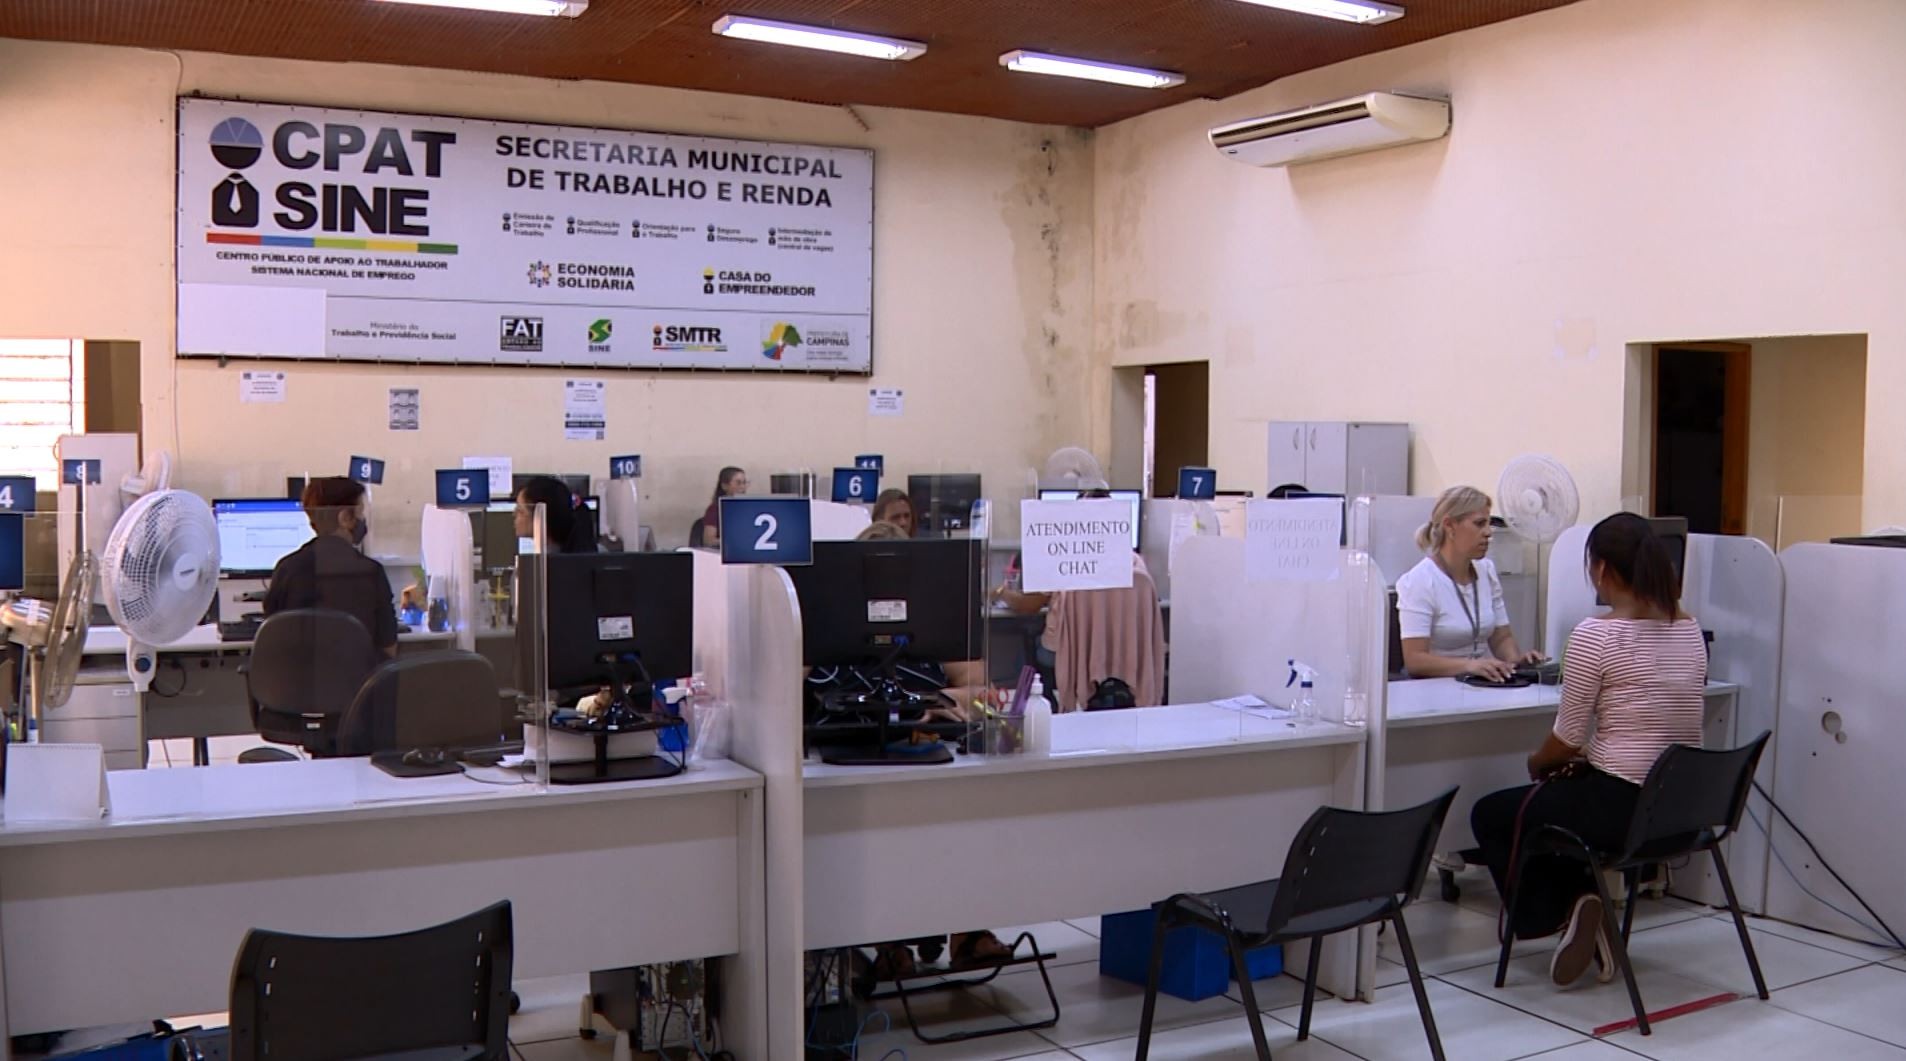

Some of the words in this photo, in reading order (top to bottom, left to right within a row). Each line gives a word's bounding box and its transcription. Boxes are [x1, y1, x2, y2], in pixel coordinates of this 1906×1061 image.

[272, 120, 457, 178] CPAT
[495, 136, 678, 168] SECRETARIA
[688, 150, 842, 179] MUNICIPAL
[507, 168, 545, 190] DE
[554, 171, 707, 200] TRABALHO
[717, 182, 732, 201] E
[742, 183, 833, 208] RENDA
[272, 181, 430, 237] SINE
[216, 251, 259, 261] CENTRO
[261, 252, 305, 263] PÚBLICO
[308, 255, 321, 264] DE
[324, 256, 355, 265] APOIO
[357, 258, 372, 266] AO
[375, 258, 448, 269] TRABALHADOR
[251, 265, 295, 275] SISTEMA
[296, 268, 349, 278] NACIONAL
[351, 270, 365, 279] DE
[367, 270, 416, 280] EMPREGO
[557, 263, 635, 278] ECONOMIA
[718, 270, 750, 282] CASA
[754, 272, 771, 283] DO
[557, 276, 635, 291] SOLIDÁRIA
[718, 283, 816, 297] EMPREENDEDOR
[331, 329, 370, 338] Trabalho
[379, 330, 429, 339] Previdência
[431, 332, 457, 340] Social
[502, 318, 543, 338] FAT
[665, 325, 722, 344] SMTR
[806, 337, 850, 347] CAMPINAS
[361, 463, 371, 479] 9
[617, 460, 635, 475] 10
[455, 478, 471, 501] 5
[849, 475, 862, 496] 6
[1191, 476, 1203, 495] 7
[0, 485, 14, 508] 4
[754, 513, 779, 551] 2
[1026, 519, 1130, 537] ATENDIMENTO
[1047, 542, 1069, 556] ON
[1072, 541, 1105, 555] LINE
[1058, 560, 1098, 576] CHAT
